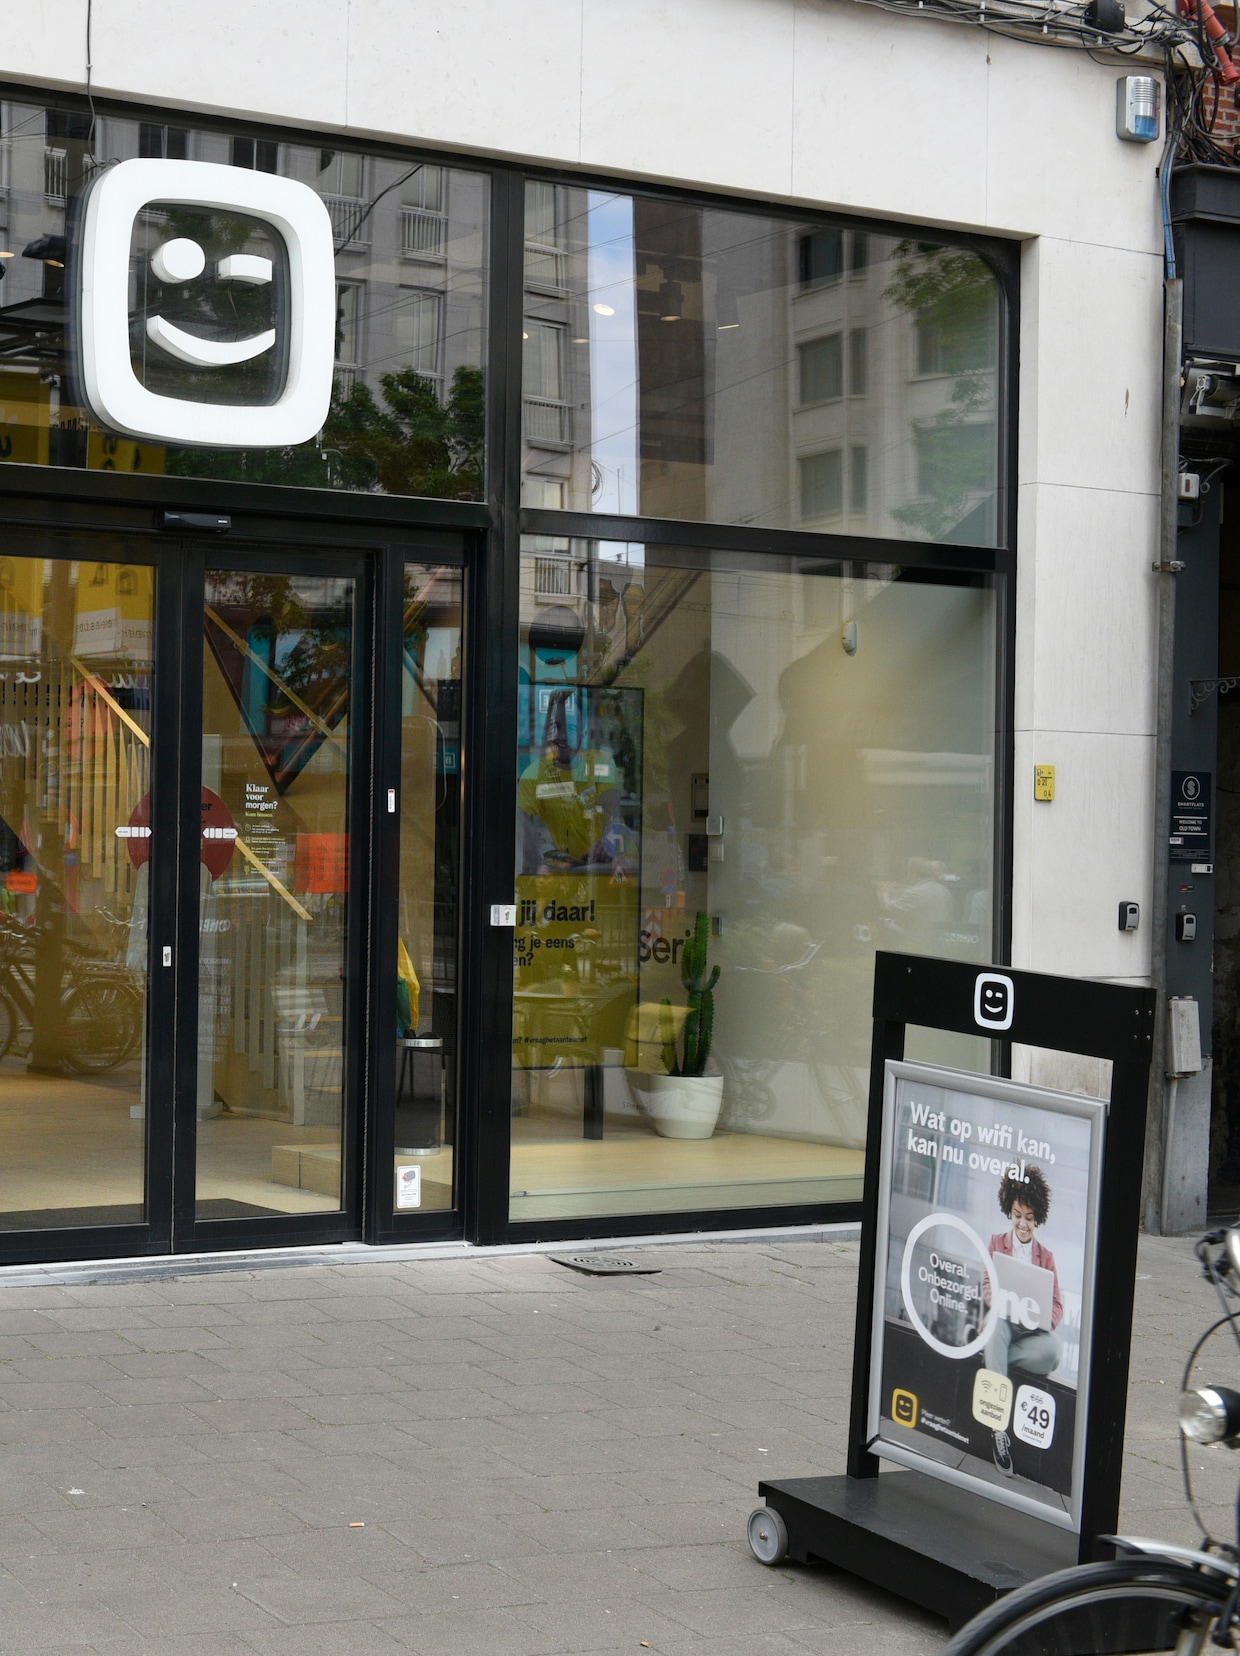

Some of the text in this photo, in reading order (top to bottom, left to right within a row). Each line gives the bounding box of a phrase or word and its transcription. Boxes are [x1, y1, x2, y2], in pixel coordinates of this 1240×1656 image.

[245, 783, 269, 793] Klaar
[245, 793, 264, 801] voor
[245, 800, 278, 812] morgen?
[519, 899, 595, 927] jij daar!
[529, 935, 541, 952] je
[545, 937, 575, 949] eens
[910, 1100, 1056, 1165] Wat op wifi kan,
[907, 1129, 1031, 1184] kan nu overal.
[929, 1252, 970, 1279] Overal.
[918, 1266, 981, 1302] Onbezorgd.
[930, 1287, 969, 1315] Online.
[979, 1399, 1005, 1414] ongezien
[980, 1408, 1002, 1422] aanbod
